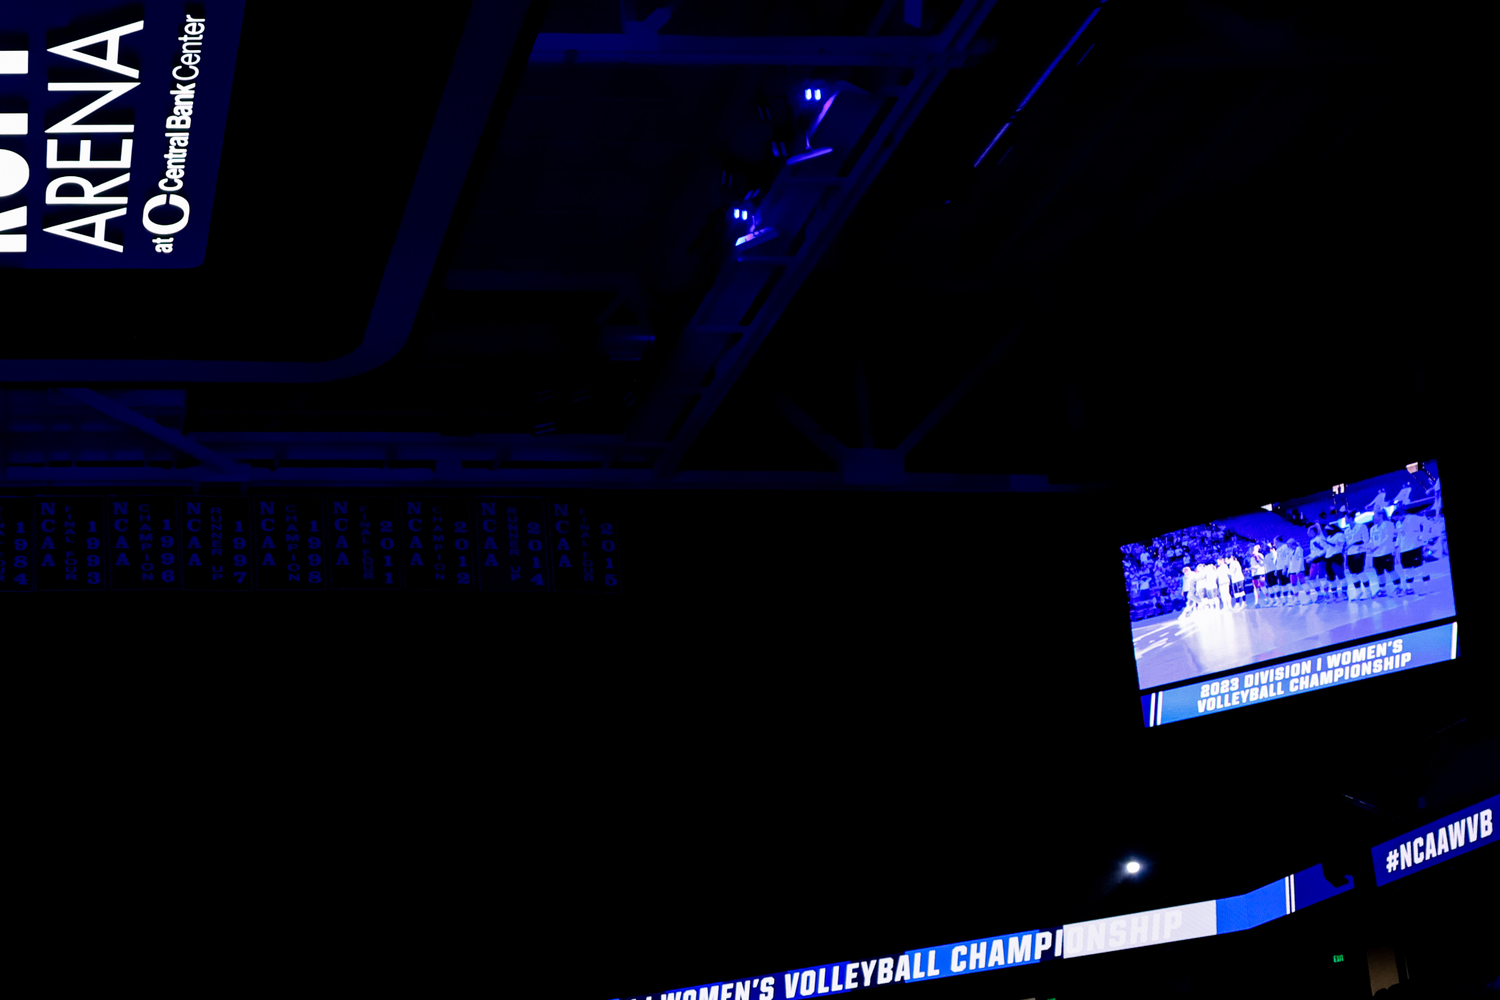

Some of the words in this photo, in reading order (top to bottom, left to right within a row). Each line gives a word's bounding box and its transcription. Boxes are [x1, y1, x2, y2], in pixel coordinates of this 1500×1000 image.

[172, 14, 206, 81] Center
[42, 20, 144, 253] ARENA
[166, 84, 196, 130] Bank
[158, 132, 190, 192] Central
[152, 237, 174, 254] at
[14, 522, 28, 585] 1984
[40, 502, 56, 566] NCAA
[64, 506, 76, 542] FINAL
[86, 521, 100, 584] 1993
[113, 502, 130, 566] NCAA
[138, 504, 154, 581] CHAMPION
[160, 519, 175, 582] 1996
[186, 502, 202, 566] NCAA
[211, 507, 222, 556] RUNNER
[233, 520, 246, 584] 1997
[260, 502, 276, 566] NCAA
[286, 504, 300, 582] CHAMPION
[308, 520, 322, 584] 1998
[333, 502, 350, 566] NCAA
[360, 506, 371, 544] FINAL
[380, 520, 394, 584] 2011
[406, 502, 424, 566] NCAA
[432, 506, 445, 580] CHAMPION
[454, 522, 470, 584] 2012
[480, 502, 499, 566] NCAA
[507, 508, 520, 556] RUNNER
[527, 522, 544, 586] 2014
[554, 504, 572, 568] NCAA
[580, 508, 591, 546] FINAL
[600, 523, 618, 586] 2015
[64, 551, 77, 580] FOUR
[212, 566, 223, 580] UP
[362, 550, 374, 580] FOUR
[510, 566, 520, 581] UP
[582, 552, 594, 582] FOUR
[1197, 682, 1284, 713] VOLLEYBALL
[1289, 652, 1411, 692] CHAMPIONSHIP
[1200, 677, 1239, 698] 2023
[1244, 660, 1312, 689] DIVISION
[1316, 657, 1323, 671] I
[1326, 638, 1403, 668] WOMEN'S
[1385, 808, 1493, 873] #NCAAWVB
[784, 950, 941, 999] VOLLEYBALL
[950, 908, 1182, 974] CHAMPIONSHIP
